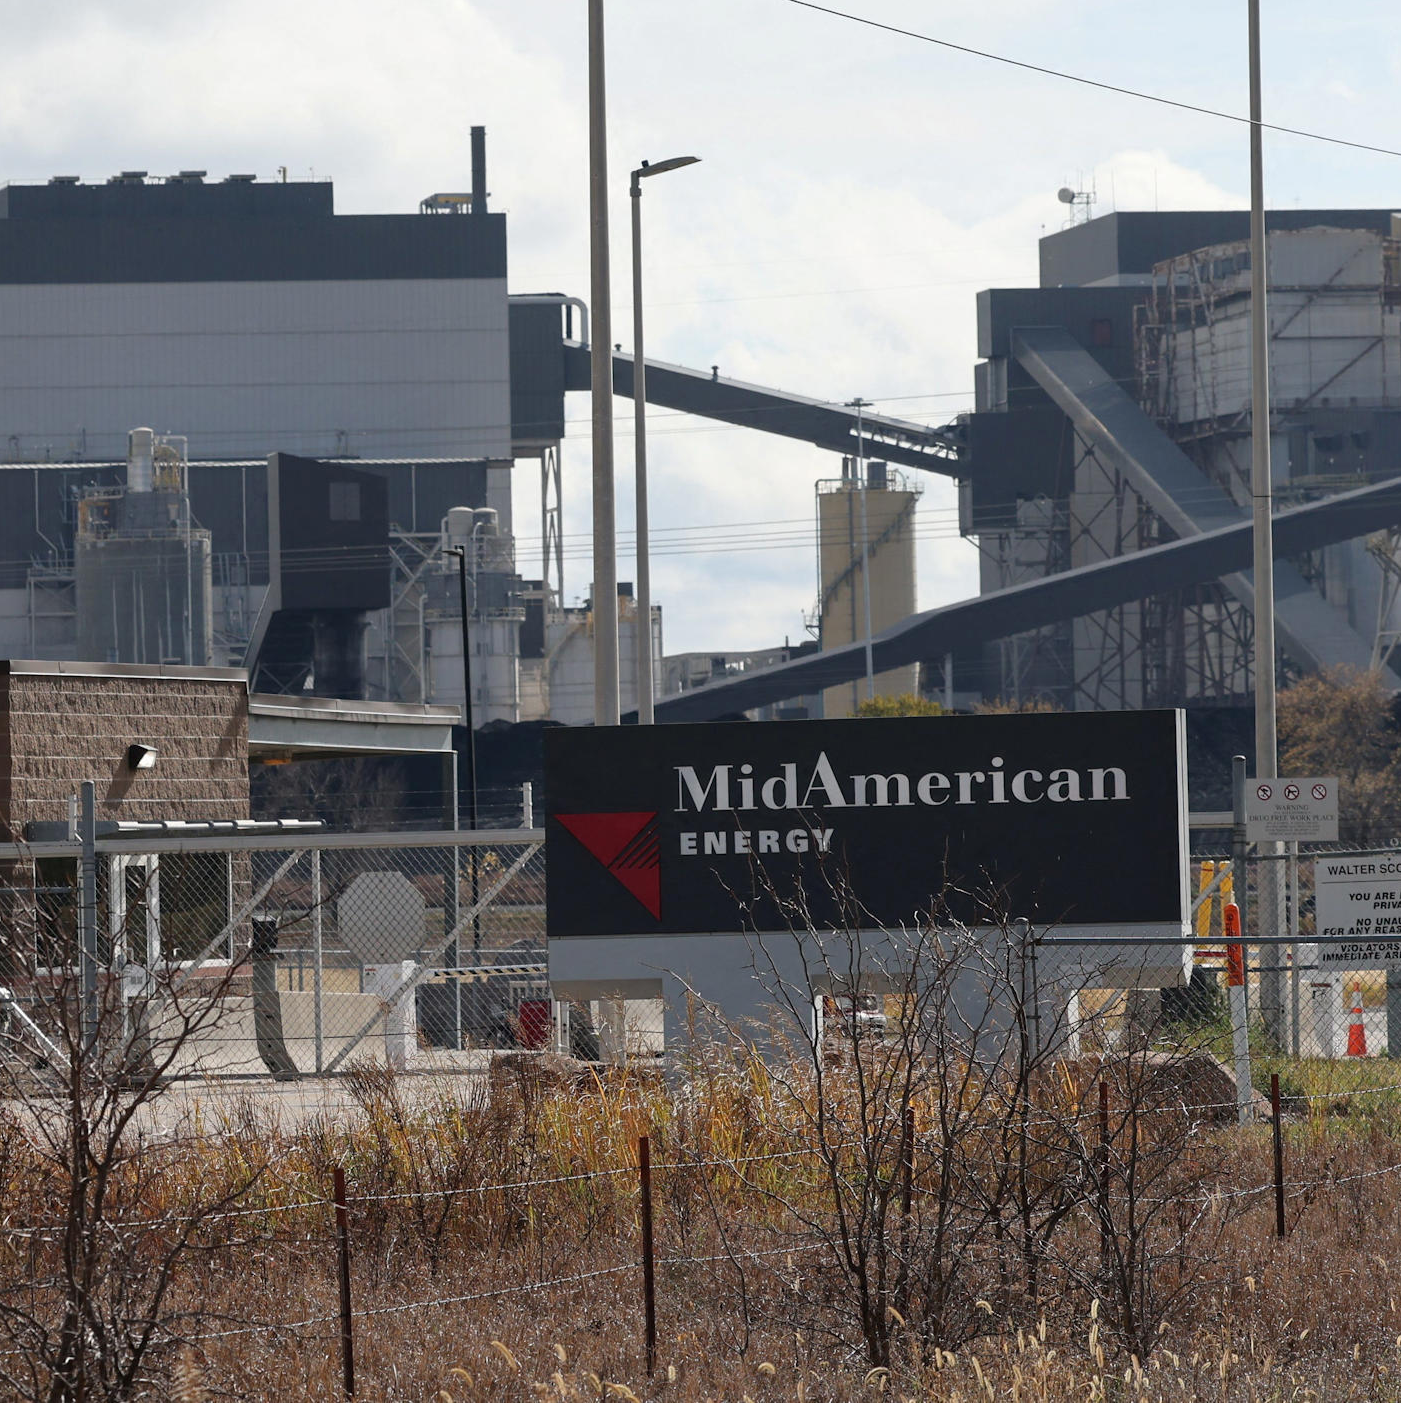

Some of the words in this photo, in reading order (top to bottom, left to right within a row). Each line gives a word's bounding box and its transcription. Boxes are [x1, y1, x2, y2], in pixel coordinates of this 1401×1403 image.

[673, 751, 1131, 813] MidAmerican
[679, 828, 834, 856] ENERGY
[1328, 864, 1376, 876] WALTER
[1349, 893, 1371, 901] YOU
[1374, 892, 1396, 900] ARE
[1356, 918, 1372, 926] NO
[1323, 927, 1344, 936] FOR
[1347, 926, 1371, 935] ANY
[1341, 943, 1400, 953] VIOLATORS
[1322, 951, 1381, 961] IMMEDIATE
